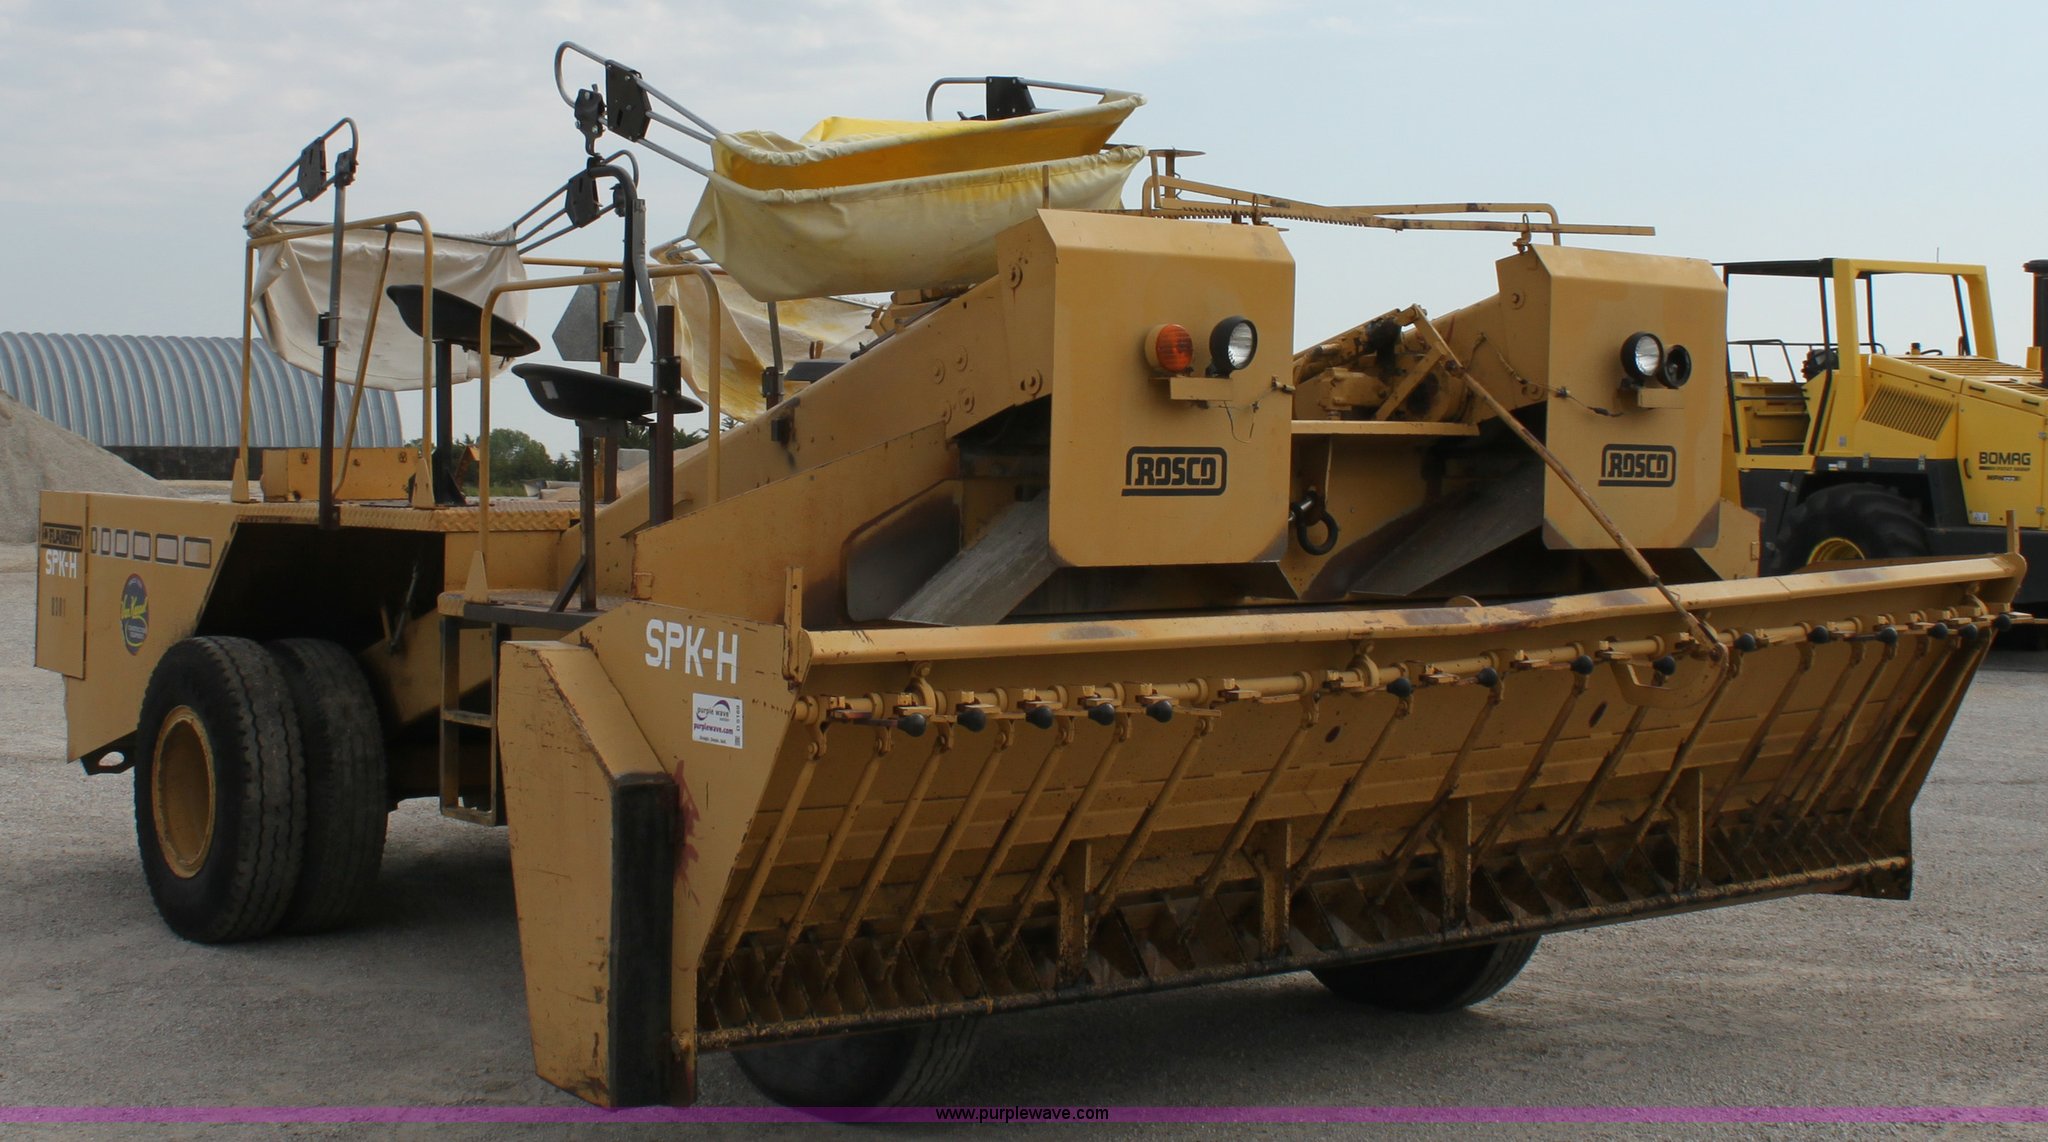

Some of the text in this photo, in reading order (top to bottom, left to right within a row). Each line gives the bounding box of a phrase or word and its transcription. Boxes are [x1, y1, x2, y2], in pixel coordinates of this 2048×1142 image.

[1134, 456, 1217, 486] ROSCO
[1607, 452, 1669, 478] ROSCO
[1979, 451, 2031, 466] BOMAG
[45, 549, 77, 579] SPK-H
[644, 618, 738, 684] SPK-H
